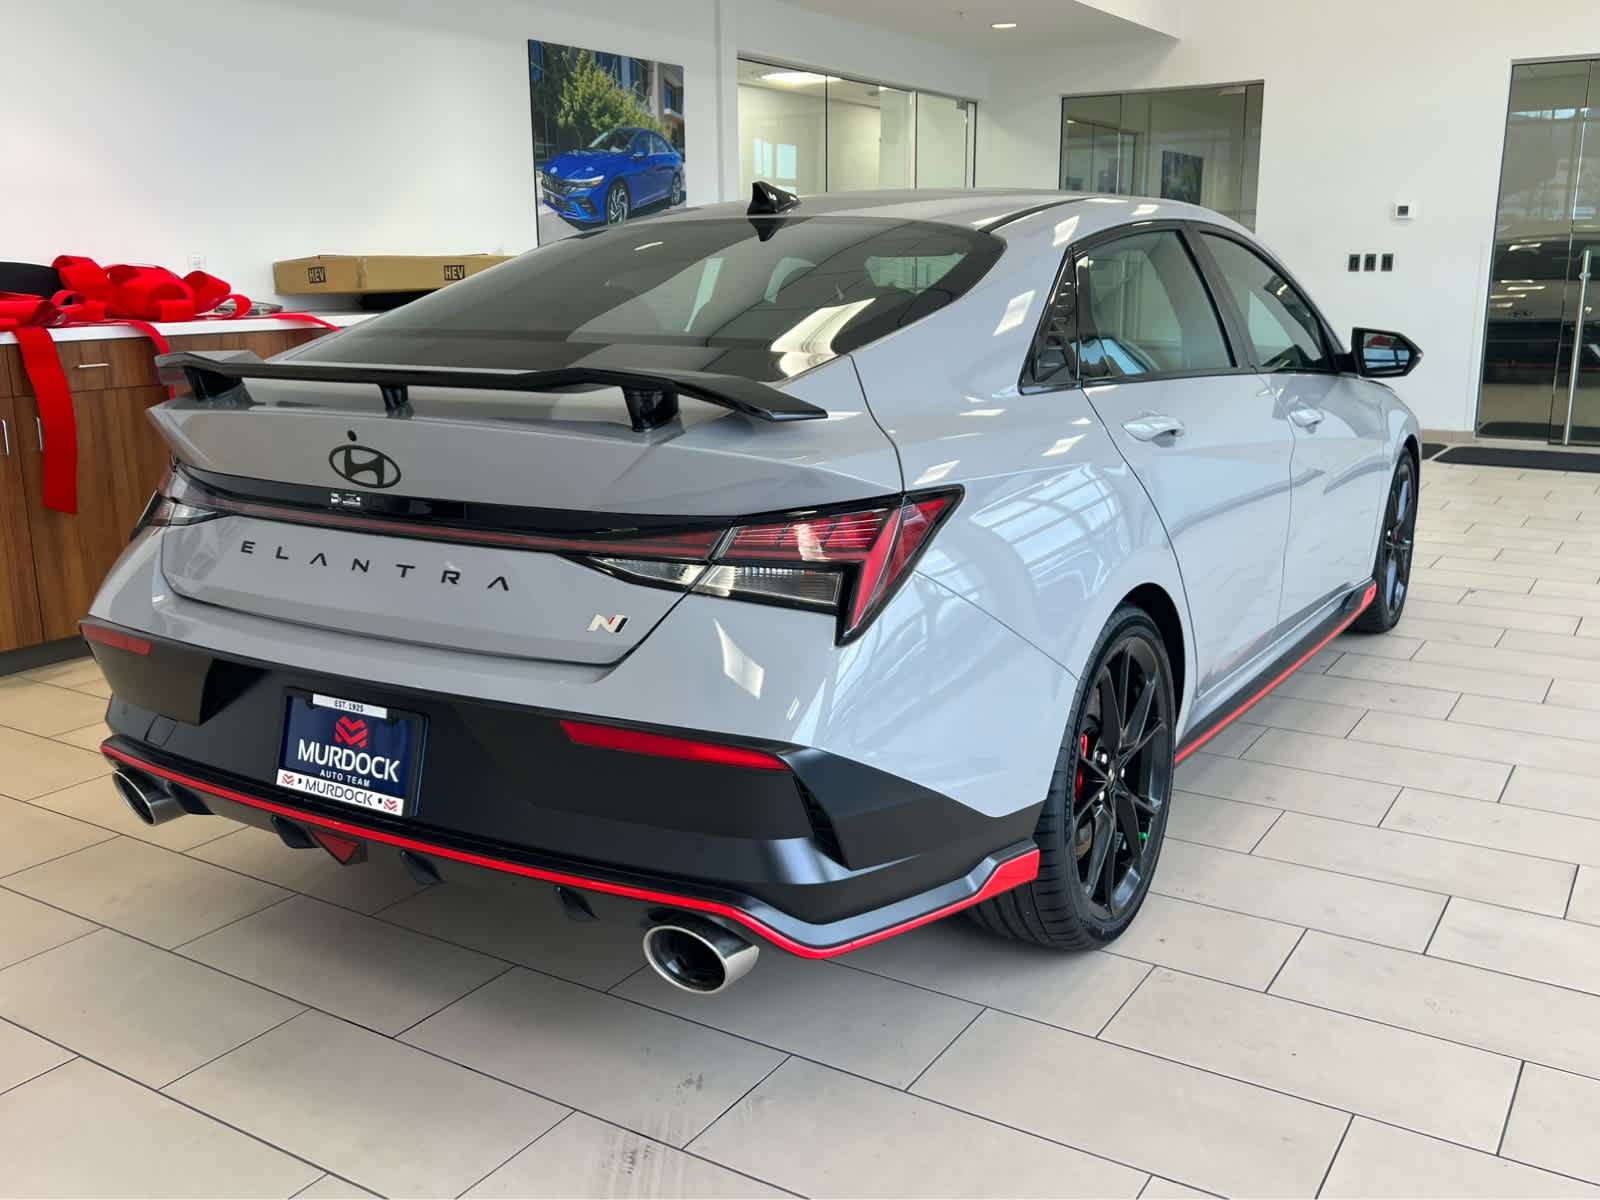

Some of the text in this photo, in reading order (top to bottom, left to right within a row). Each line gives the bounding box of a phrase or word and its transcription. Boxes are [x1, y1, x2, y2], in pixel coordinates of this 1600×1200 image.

[309, 267, 325, 282] HEV
[445, 266, 464, 280] HEV
[240, 540, 510, 592] ELANTRA
[297, 738, 401, 783] MURDOCK
[320, 769, 370, 787] AUTO TEAM
[304, 778, 374, 807] MURDOCK
